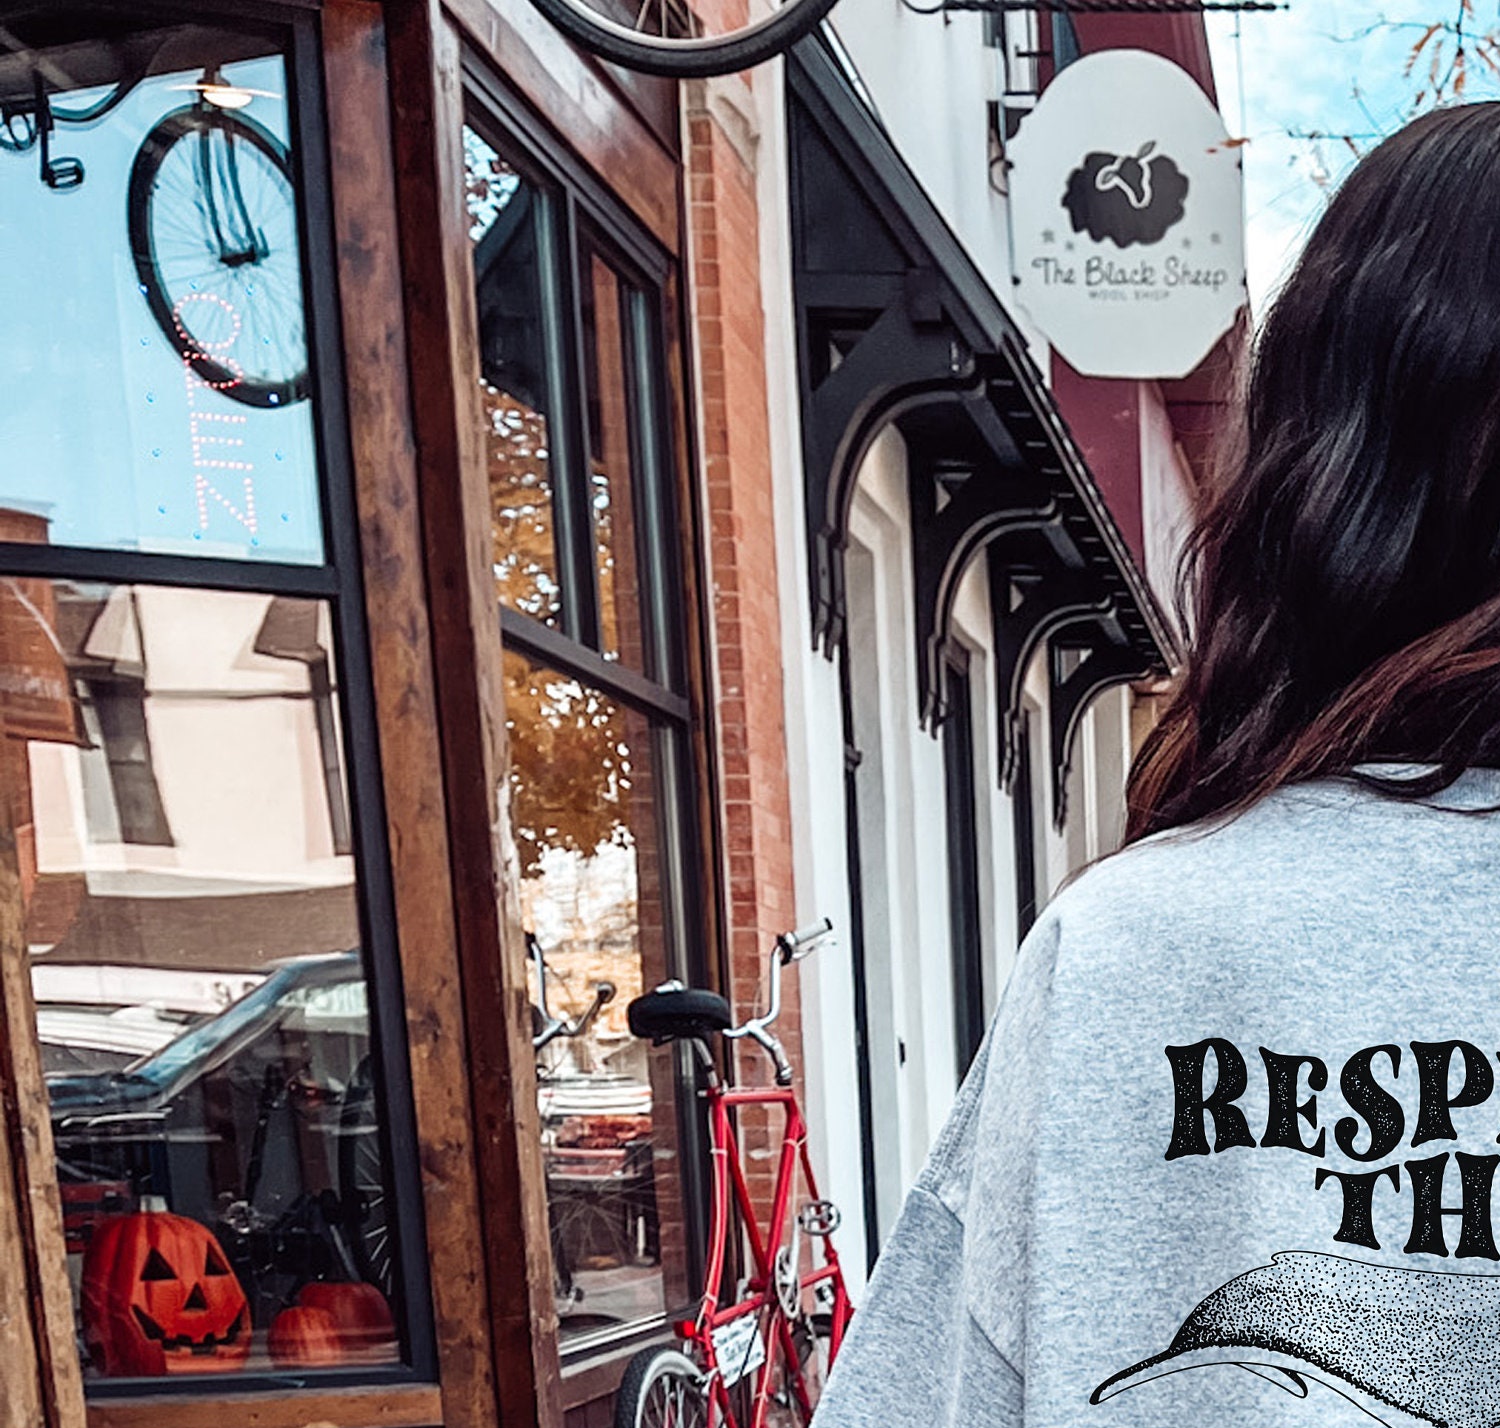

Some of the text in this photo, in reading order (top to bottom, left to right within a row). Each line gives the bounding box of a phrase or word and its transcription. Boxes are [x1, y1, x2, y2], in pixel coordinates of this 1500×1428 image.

[1031, 255, 1227, 292] The Black Sheep
[173, 293, 256, 534] OPEN
